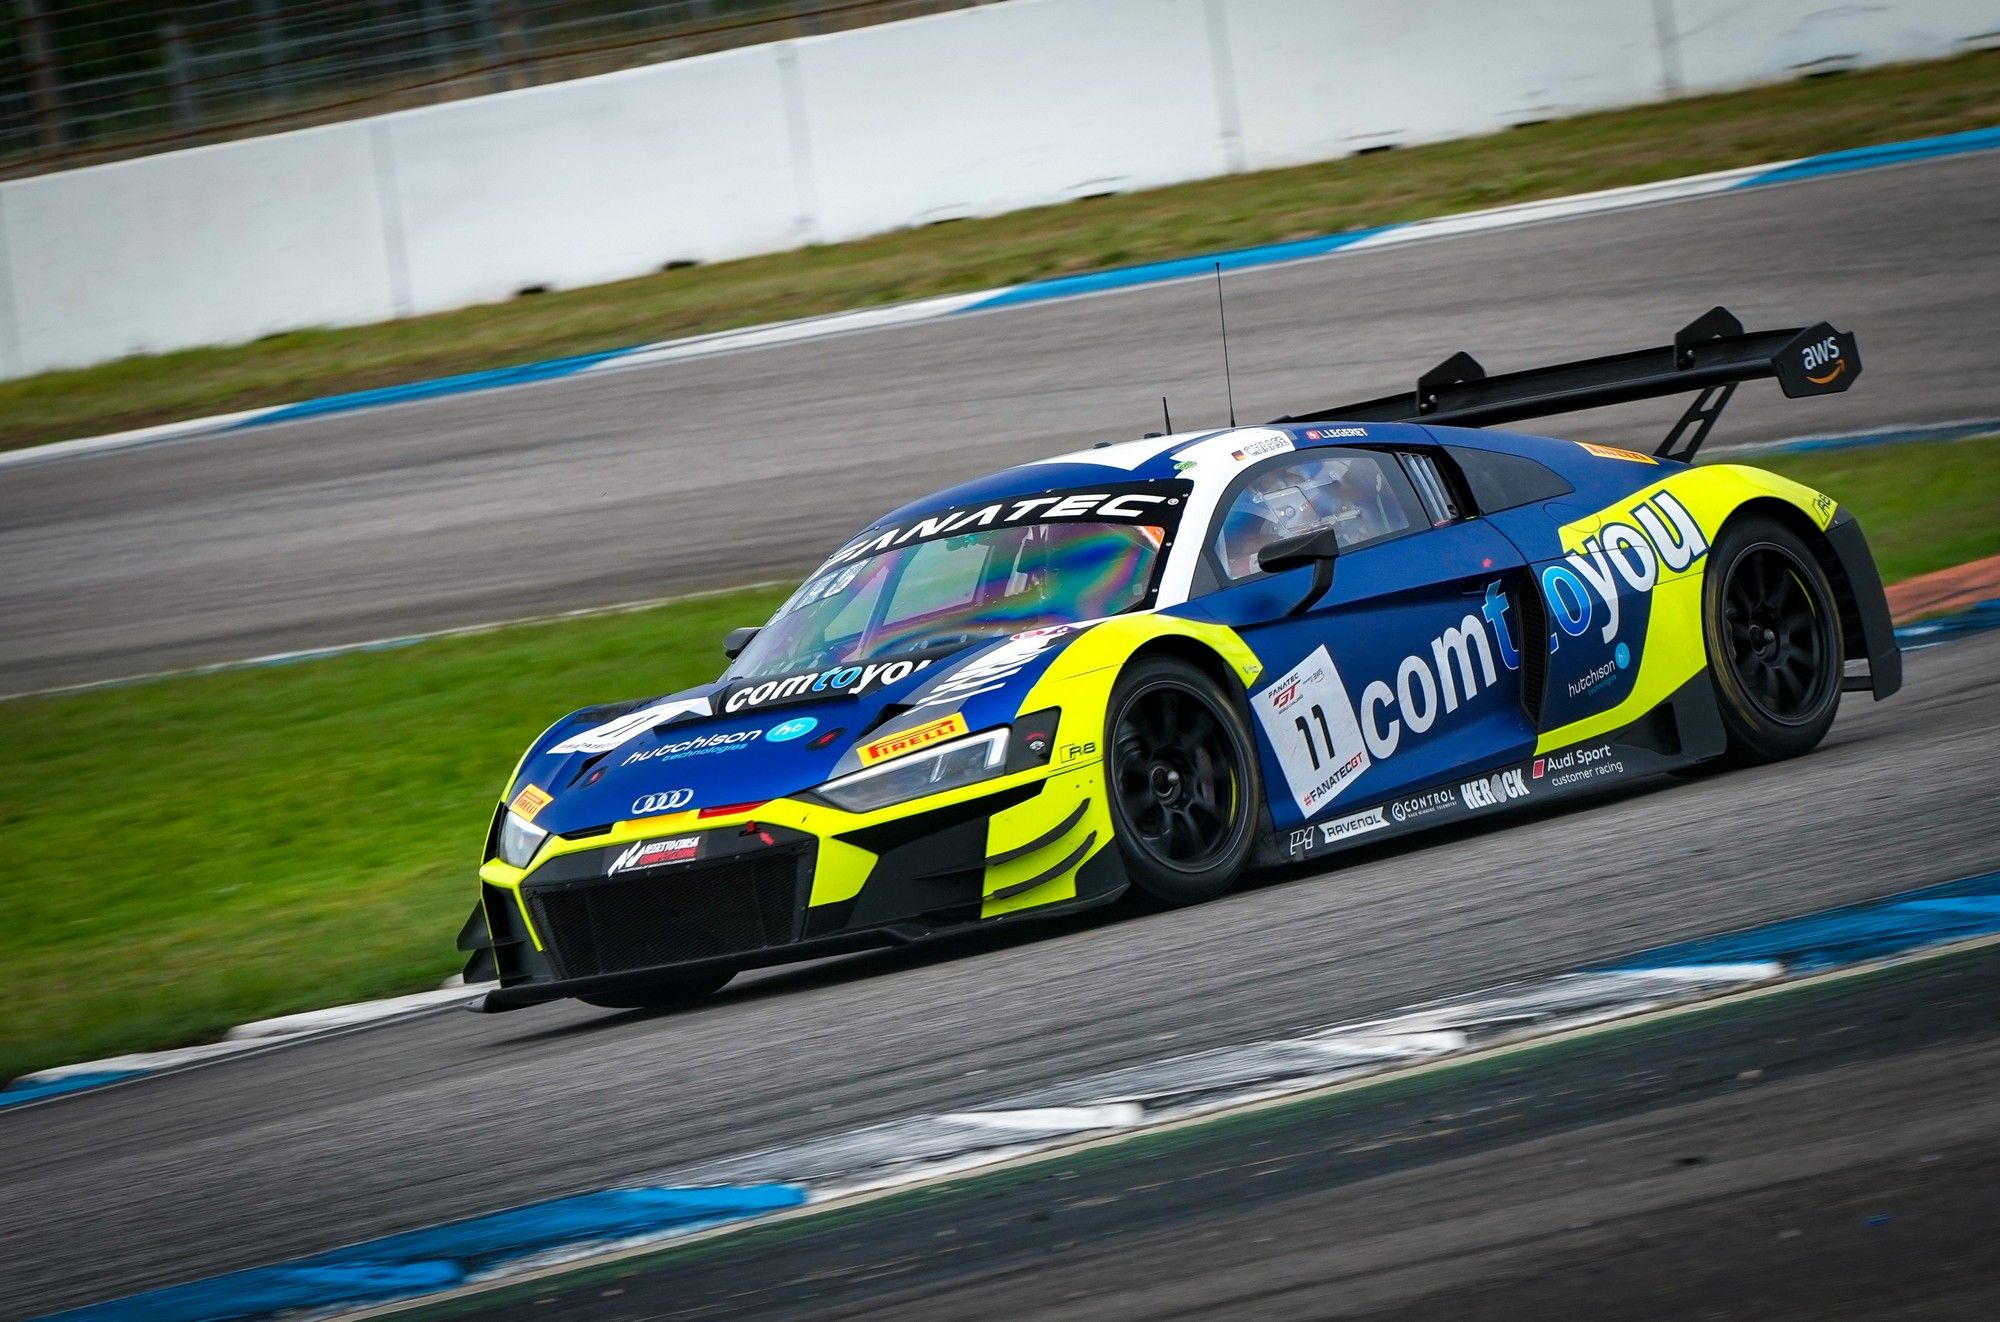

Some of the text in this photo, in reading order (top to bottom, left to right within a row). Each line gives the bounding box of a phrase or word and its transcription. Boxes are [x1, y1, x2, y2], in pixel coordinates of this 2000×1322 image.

[1801, 336, 1840, 370] aws
[1359, 488, 1711, 761] comtoyou
[724, 659, 932, 713] comtoyo
[1267, 672, 1300, 699] FANATEC
[1567, 660, 1616, 698] hutchison
[620, 729, 763, 766] hutchison
[661, 743, 749, 762] technologies
[867, 719, 956, 759] PIRELLI
[1069, 742, 1096, 760] R8
[1294, 703, 1336, 771] 11
[1547, 744, 1612, 772] Audi Sport
[1551, 760, 1624, 787] customer racing
[1303, 751, 1364, 807] #FANATECGT
[1460, 768, 1531, 810] HEROCK
[1404, 789, 1455, 813] CONTROL
[1327, 814, 1382, 838] RAVENOL
